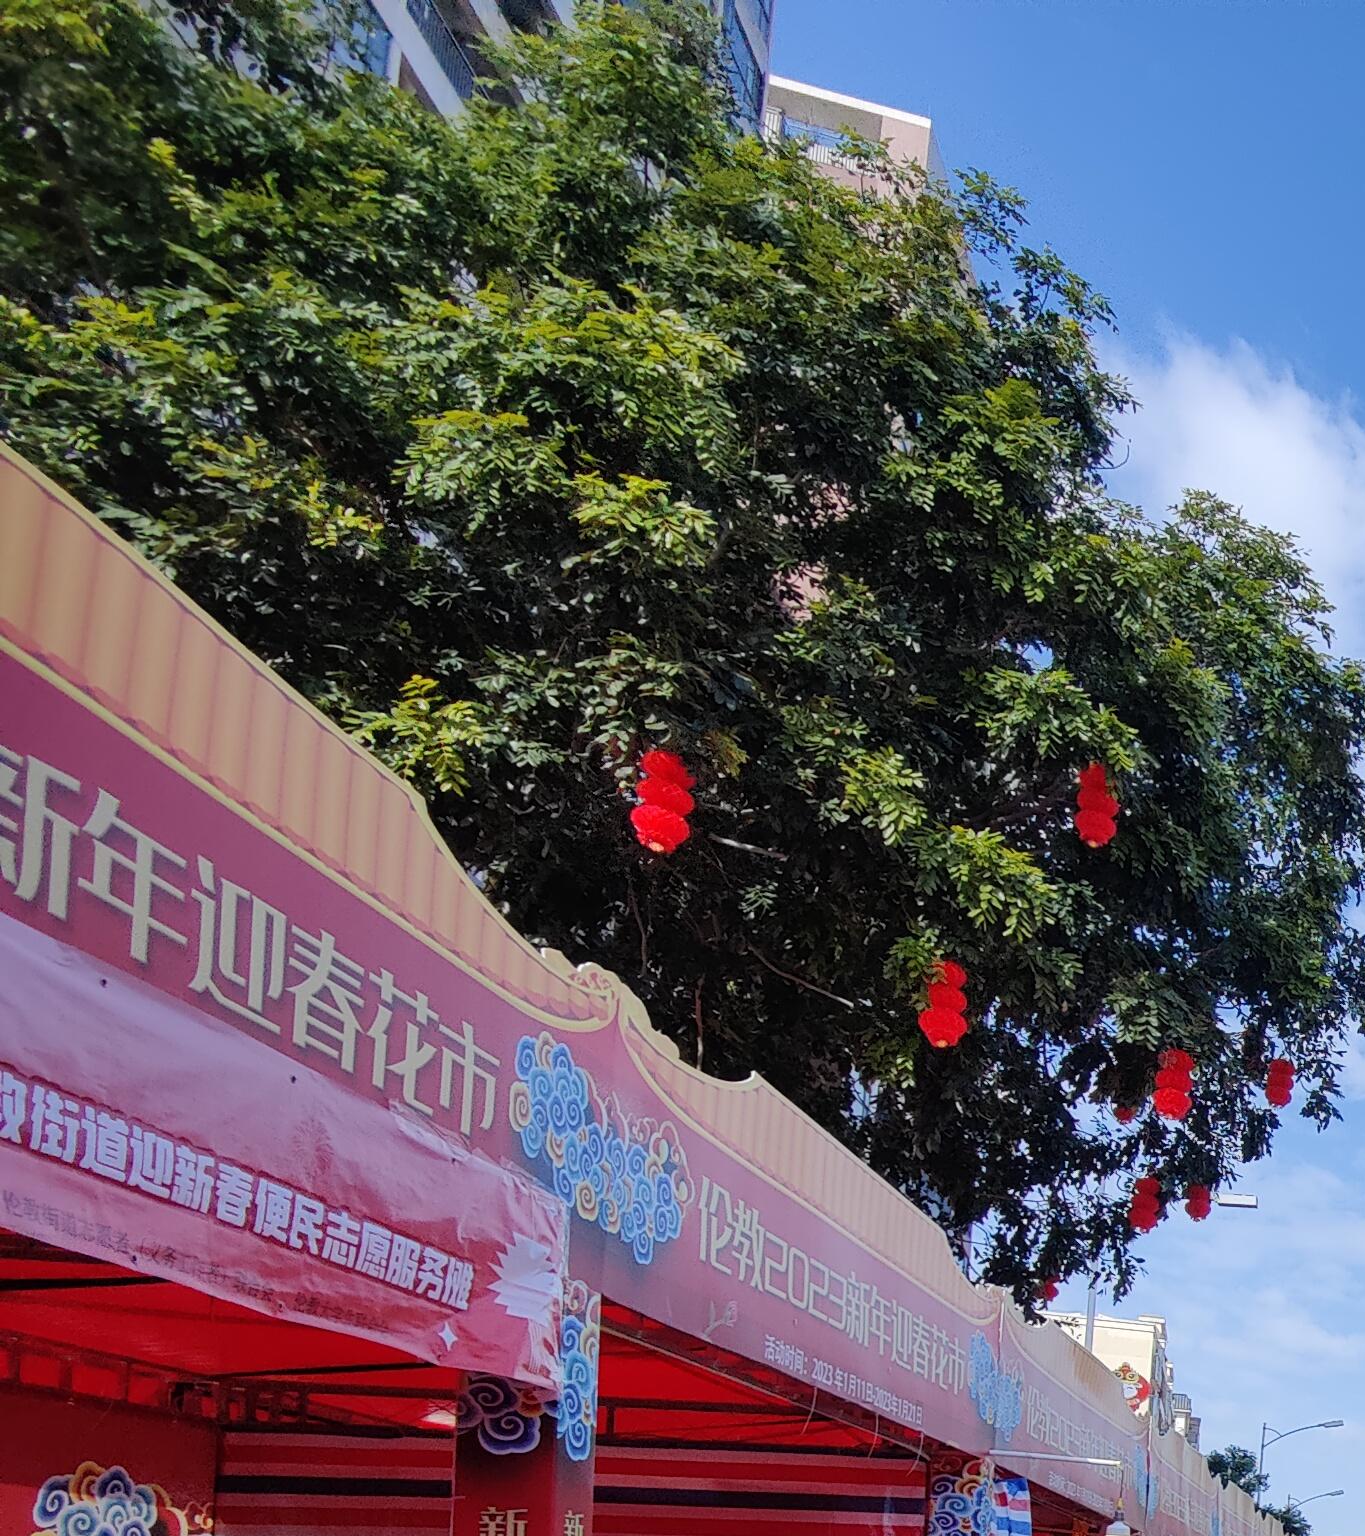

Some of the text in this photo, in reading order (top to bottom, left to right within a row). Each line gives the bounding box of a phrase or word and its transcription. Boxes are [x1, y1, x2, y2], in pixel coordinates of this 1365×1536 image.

[699, 1174, 967, 1396] 伦教2023新年迎春花市
